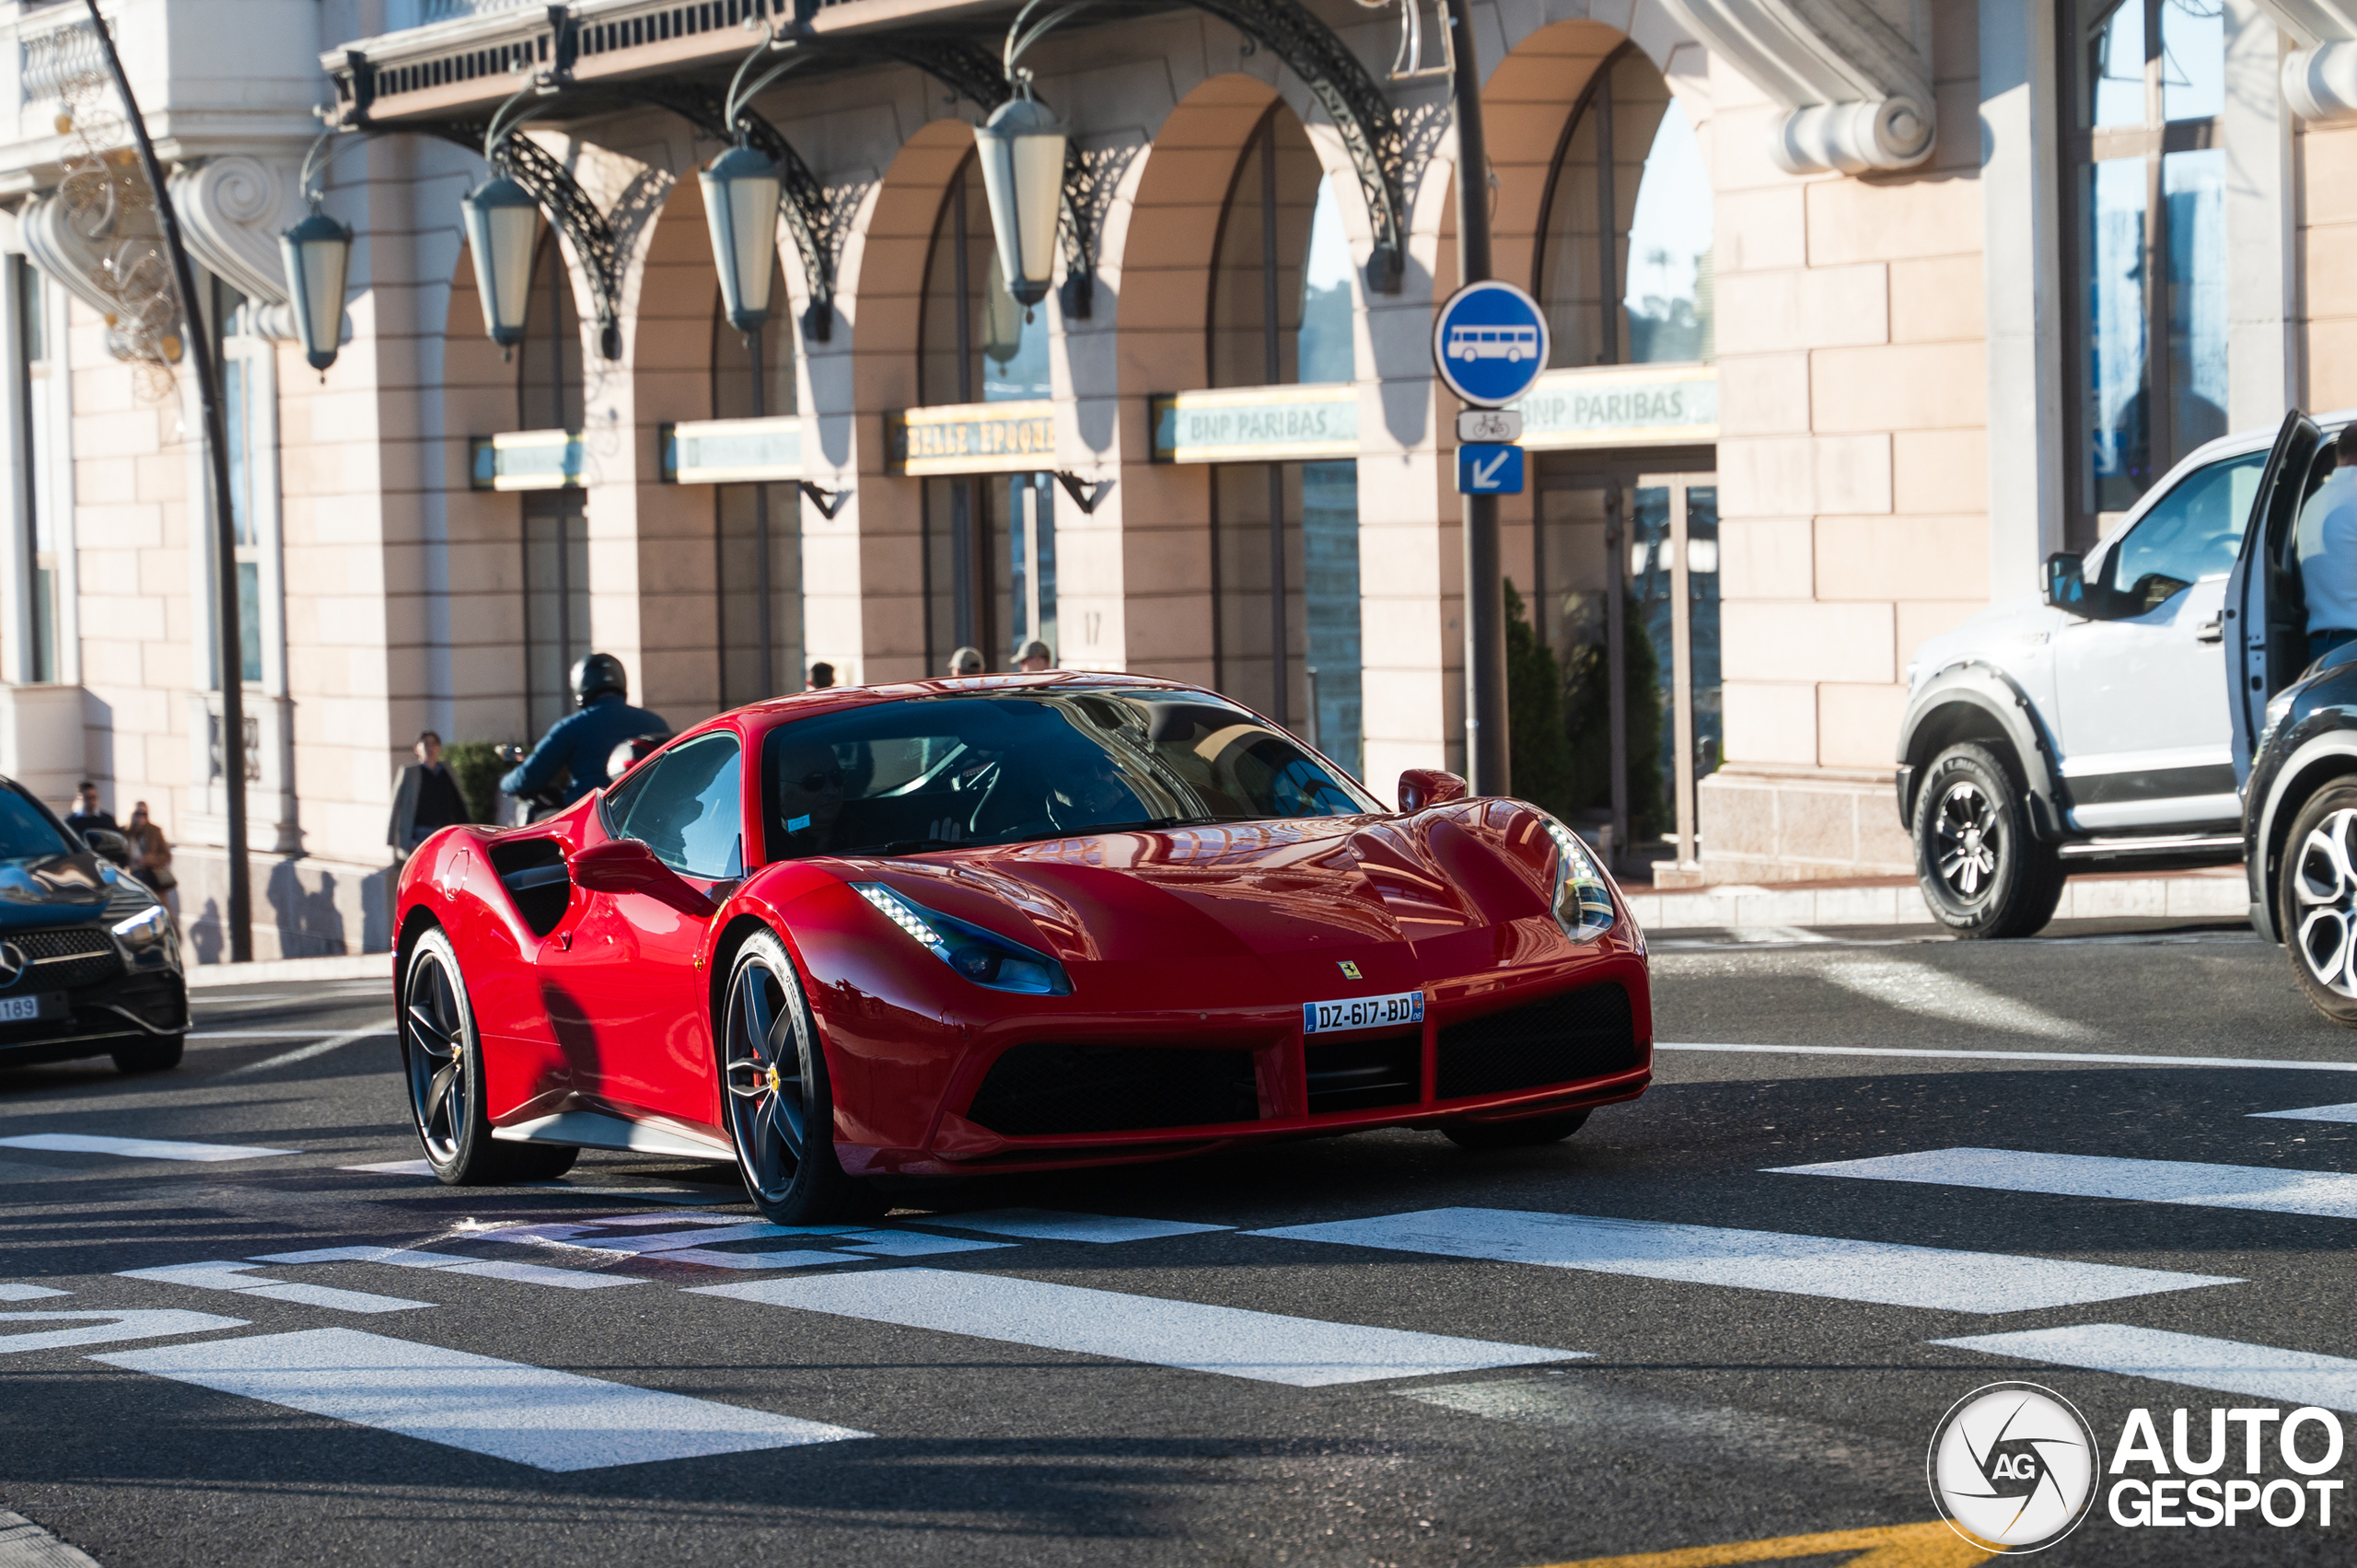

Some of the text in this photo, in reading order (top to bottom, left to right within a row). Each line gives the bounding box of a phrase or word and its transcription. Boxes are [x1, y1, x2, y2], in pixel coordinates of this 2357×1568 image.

[1519, 390, 1683, 425] BNP PARIBAS
[907, 424, 968, 456] BELLE
[1190, 415, 1231, 441] BNP
[1237, 411, 1327, 439] PARIBAS
[1085, 610, 1102, 645] 17
[1318, 998, 1411, 1028] DZ-617-BD
